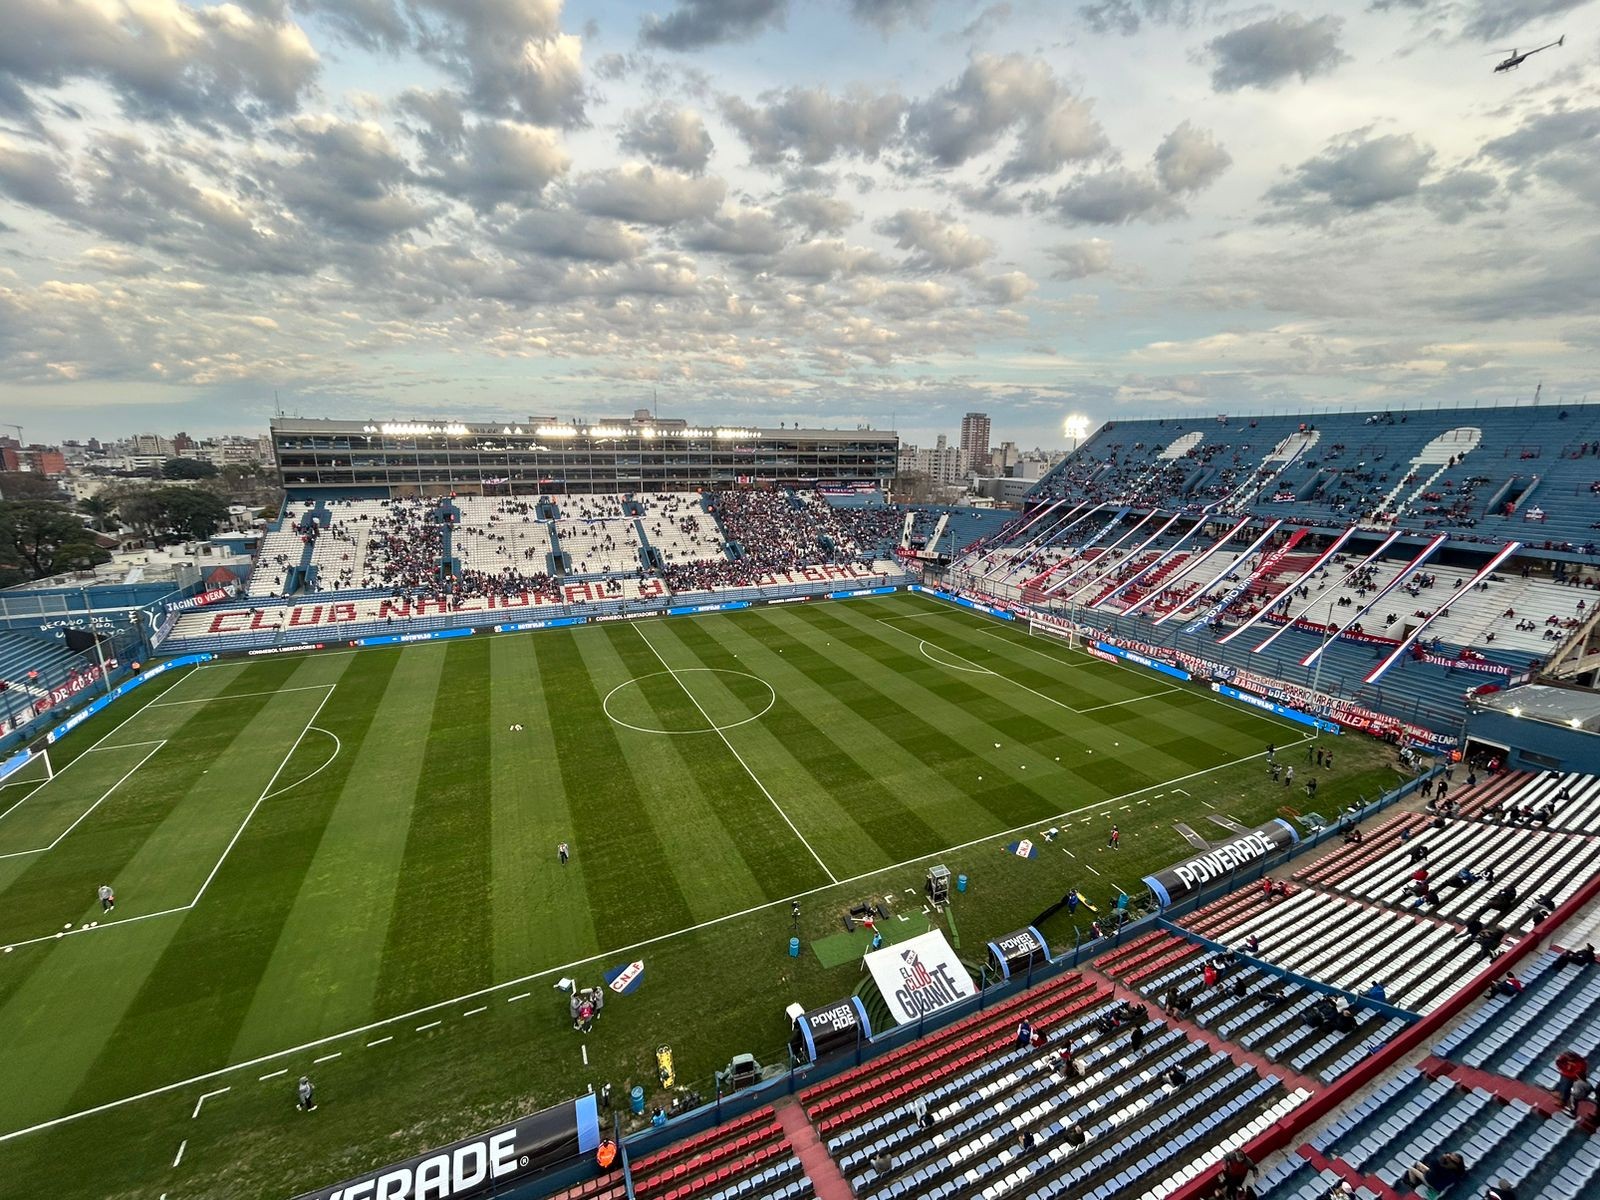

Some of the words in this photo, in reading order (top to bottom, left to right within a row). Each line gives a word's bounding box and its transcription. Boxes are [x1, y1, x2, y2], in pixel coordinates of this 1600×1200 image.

[1240, 561, 1274, 590] PIBES
[166, 597, 203, 611] JACINTO
[205, 590, 225, 601] VERA
[40, 618, 84, 631] DECANO
[91, 616, 112, 624] DEL
[208, 603, 357, 632] CLUB
[1173, 830, 1276, 890] POWERADE
[999, 932, 1033, 951] POWER
[899, 967, 912, 979] EL
[905, 961, 933, 991] CLUB
[895, 962, 966, 1019] GIGANTE
[810, 1004, 852, 1027] POWER
[832, 1013, 856, 1031] ADE
